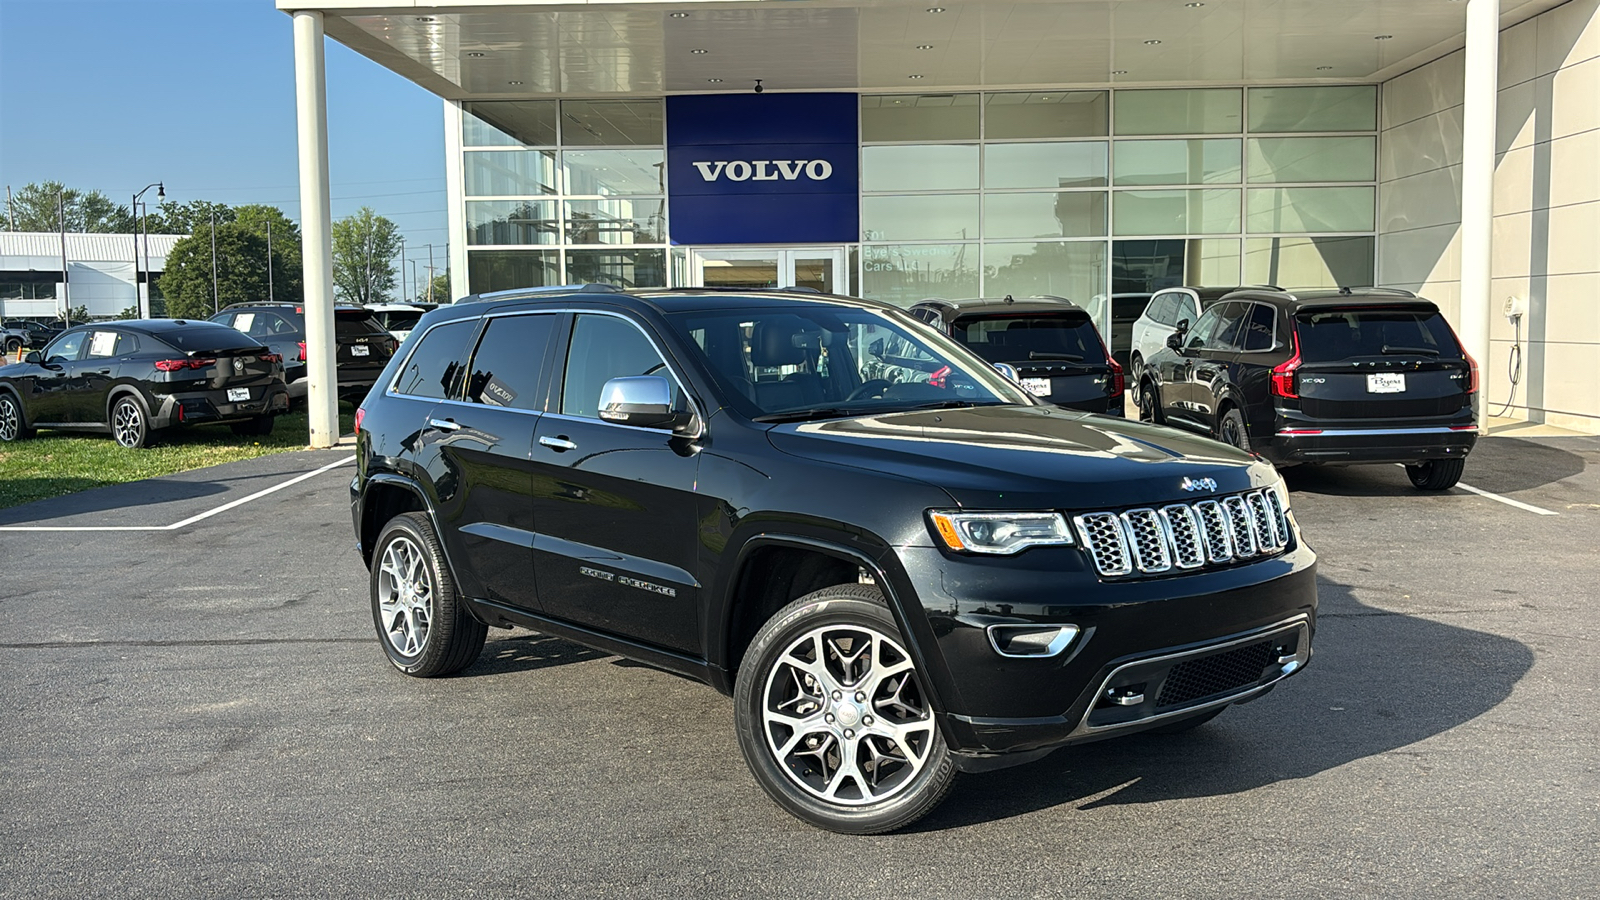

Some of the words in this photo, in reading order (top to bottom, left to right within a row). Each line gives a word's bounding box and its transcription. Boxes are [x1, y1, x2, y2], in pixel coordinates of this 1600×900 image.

[692, 159, 833, 182] VOLVO
[864, 261, 893, 271] Cars
[897, 260, 920, 271] LLC
[1371, 377, 1401, 388] Byers
[1181, 476, 1218, 493] Jeep
